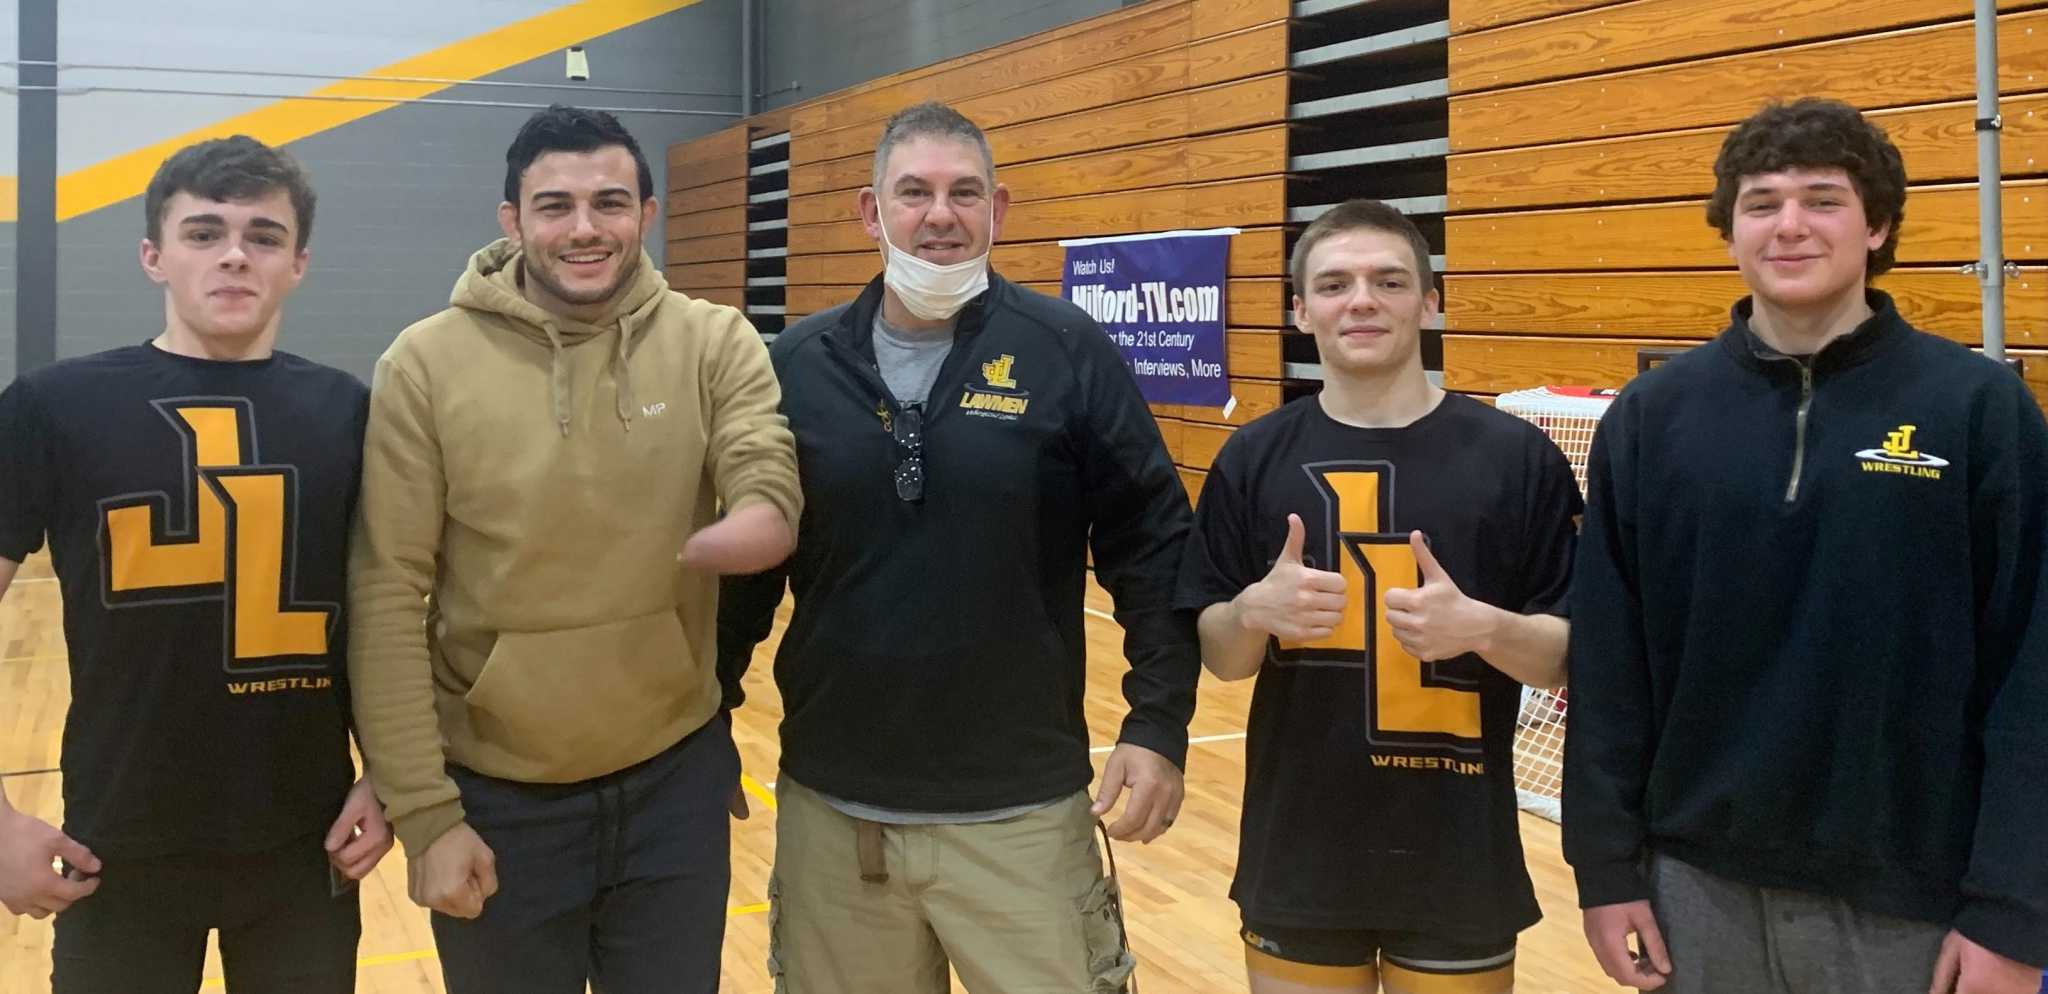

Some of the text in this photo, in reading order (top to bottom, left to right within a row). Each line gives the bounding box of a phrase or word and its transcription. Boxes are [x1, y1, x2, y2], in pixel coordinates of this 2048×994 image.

[1073, 258, 1115, 275] Watch Us!
[1118, 330, 1135, 347] the
[1136, 330, 1157, 347] 21st
[1158, 330, 1195, 351] Century
[1134, 357, 1222, 379] Interviews, More
[642, 402, 666, 417] MP
[959, 391, 1029, 415] LAWMEN
[1861, 461, 1941, 480] WRESTLING
[226, 677, 332, 695] WRESTLIN
[1369, 754, 1485, 775] WRESTLIN
